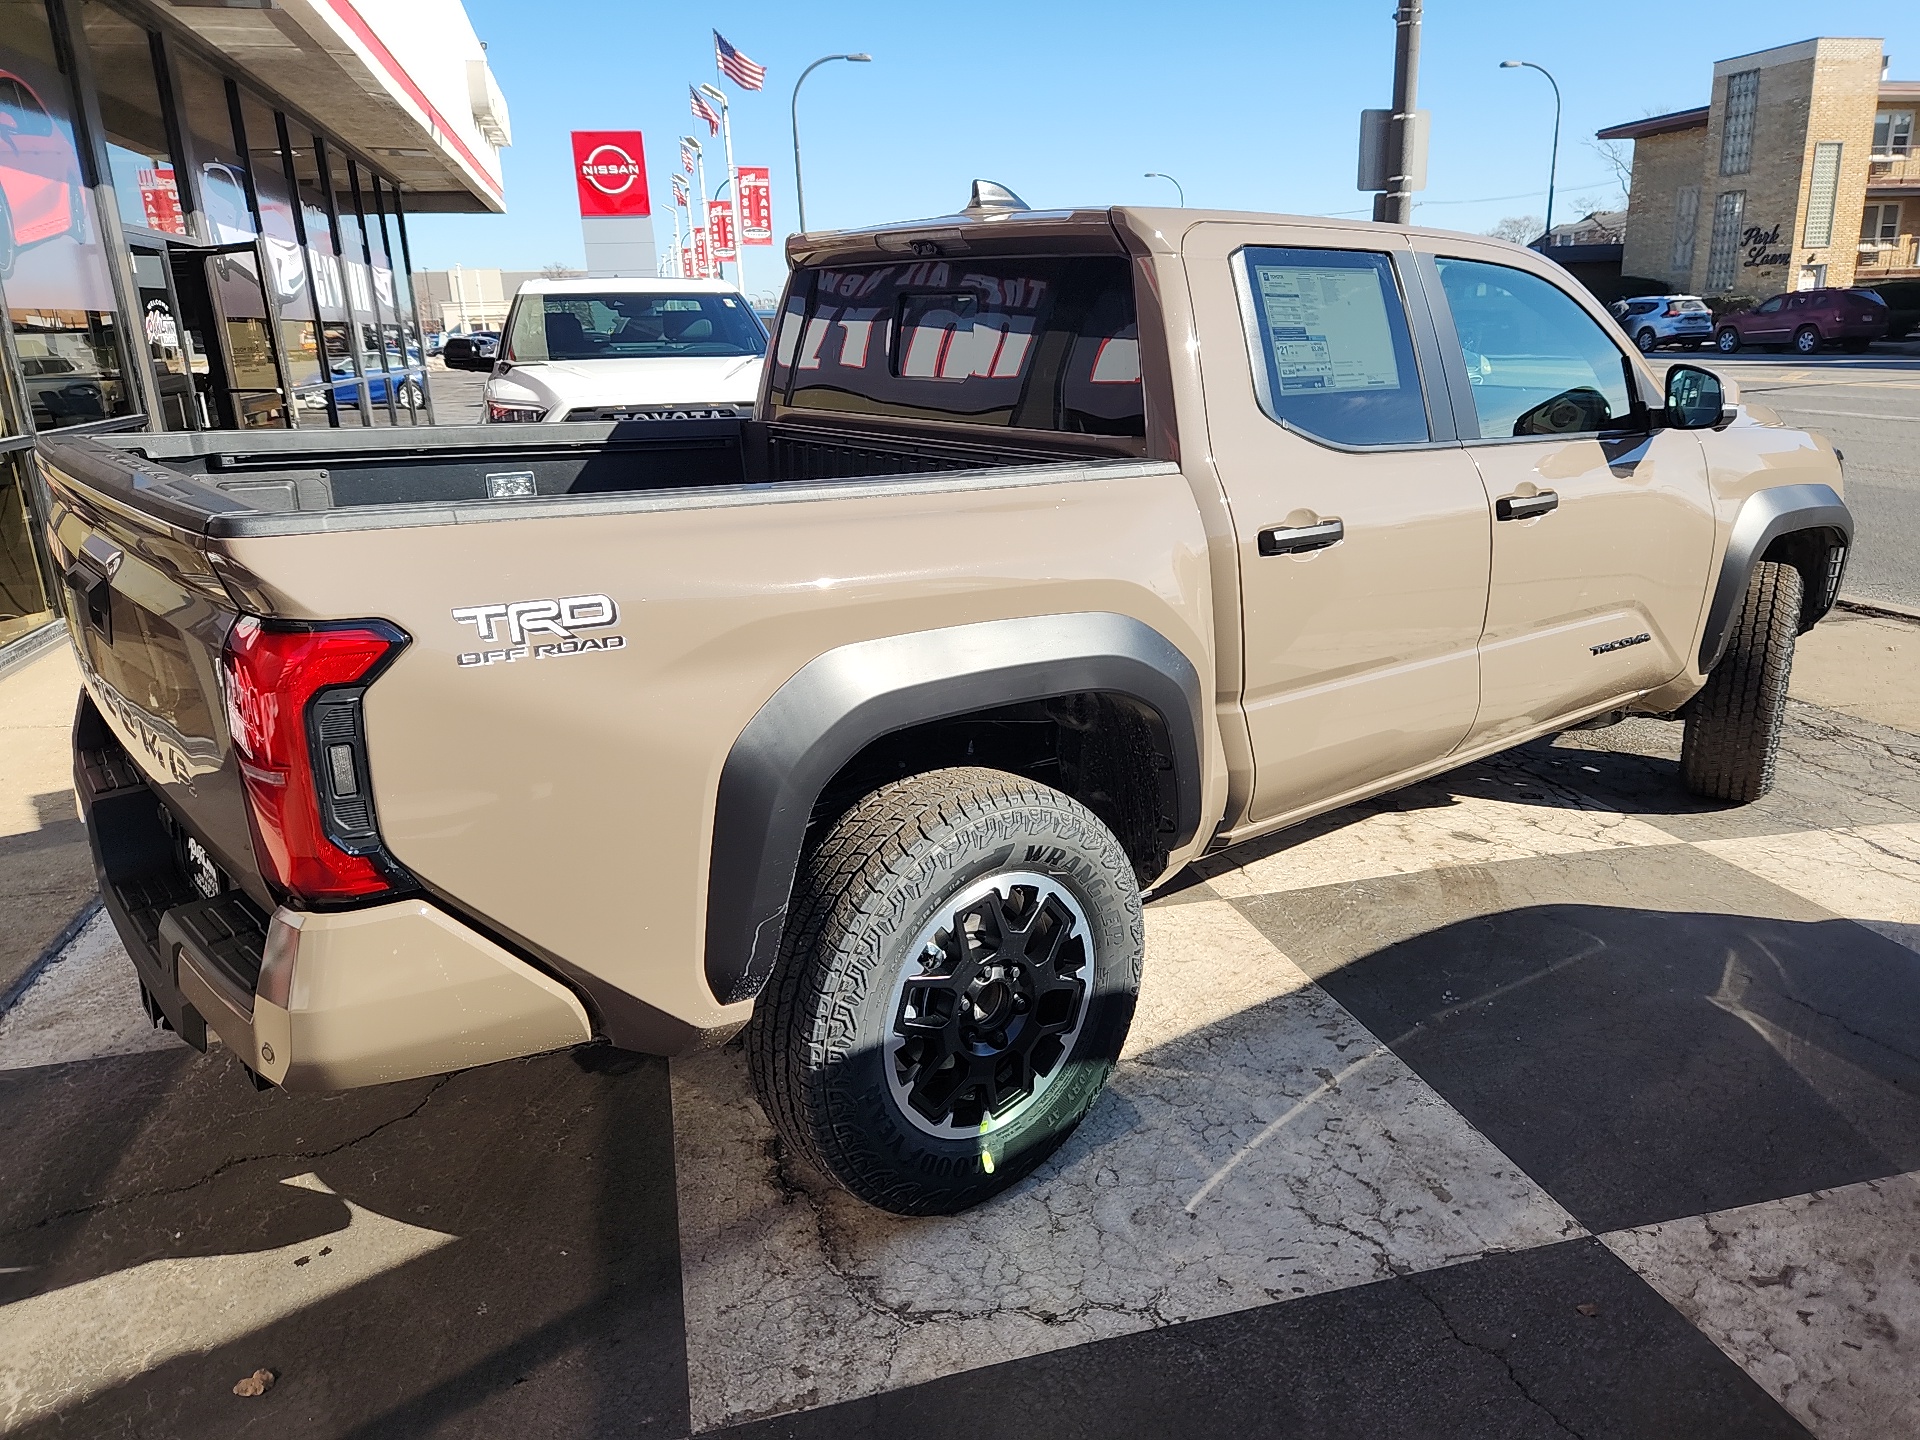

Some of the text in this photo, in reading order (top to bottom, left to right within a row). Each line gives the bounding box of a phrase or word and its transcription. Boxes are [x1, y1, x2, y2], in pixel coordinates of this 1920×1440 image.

[582, 165, 639, 175] NISSAN
[742, 188, 752, 227] USED
[759, 188, 769, 227] CARS
[726, 217, 734, 248] CARS
[1740, 224, 1780, 247] Park
[1743, 246, 1790, 267] Lawn
[1280, 345, 1288, 355] 21
[451, 594, 621, 645] TRD
[457, 635, 627, 668] OFF ROAD
[1589, 633, 1651, 656] TACOMA
[1023, 843, 1124, 948] WRANGLER
